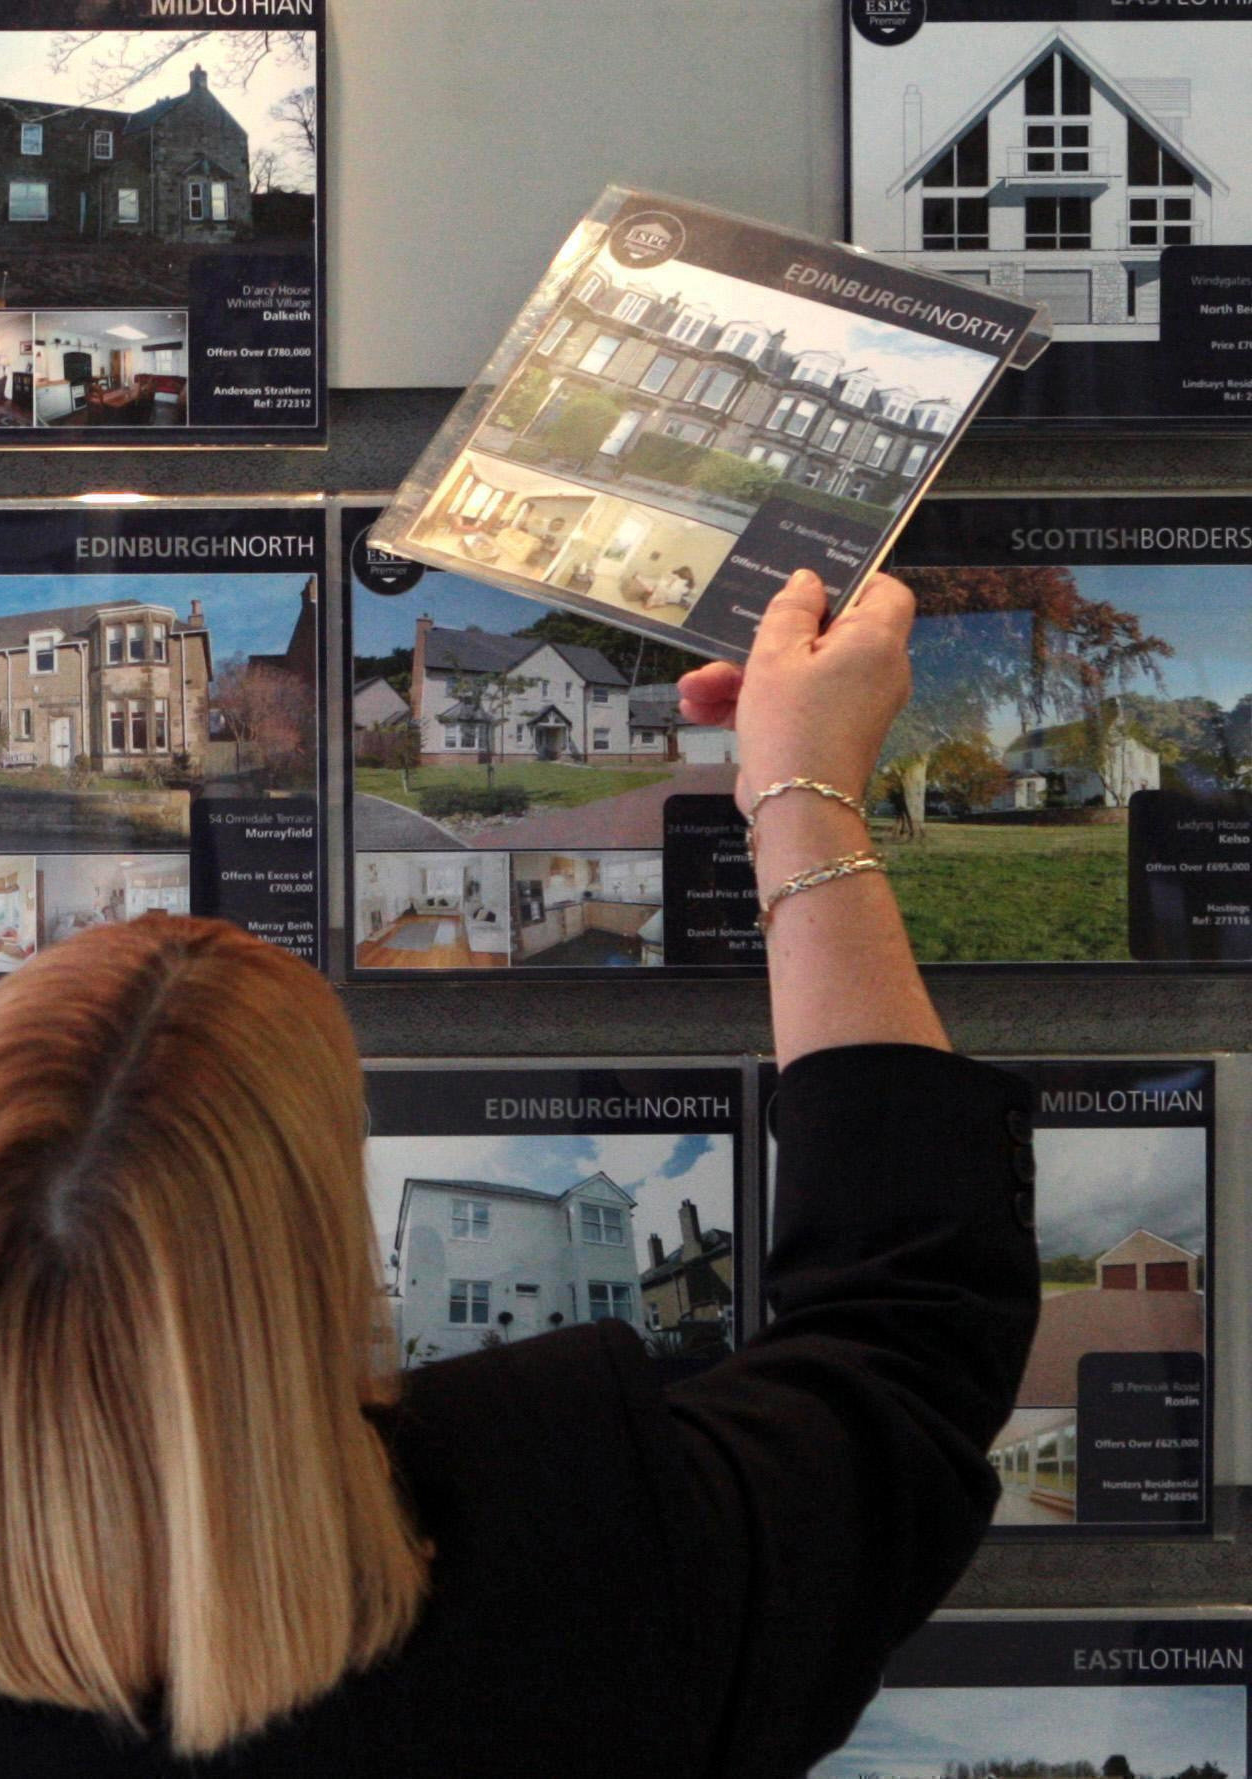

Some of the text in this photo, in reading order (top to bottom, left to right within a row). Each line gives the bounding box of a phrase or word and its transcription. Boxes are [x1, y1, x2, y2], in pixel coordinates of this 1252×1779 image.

[151, 0, 314, 16] MIDLOTHIAN
[866, 0, 911, 11] ESPC
[278, 285, 311, 296] House
[783, 263, 1015, 345] EDINBURGHNORTH
[1200, 304, 1233, 315] North
[263, 311, 311, 321] Dalkeith
[1211, 341, 1235, 351] Price
[207, 348, 237, 358] Offers
[240, 348, 265, 358] Over
[213, 386, 311, 396] Anderson Strathern
[253, 399, 273, 409] Ref:
[1011, 527, 1252, 551] SCOTTISHBORDERS
[76, 536, 314, 558] EDINBURGHNORTH
[276, 813, 314, 824] Terrace
[245, 828, 313, 841] Murrayfield
[1219, 834, 1251, 844] Kelso
[1146, 863, 1203, 872] Offers Over
[222, 871, 313, 881] Offers in Excess of
[1207, 904, 1251, 914] Hastings
[248, 922, 314, 933] Murray Beith
[297, 934, 314, 944] WS
[1041, 1090, 1204, 1113] MIDLOTHIAN
[485, 1096, 730, 1120] EDINBURGHNORTH
[1165, 1397, 1200, 1407] Roslin
[1095, 1439, 1153, 1449] Offers Over
[1073, 1648, 1244, 1671] EASTLOTHIAN
